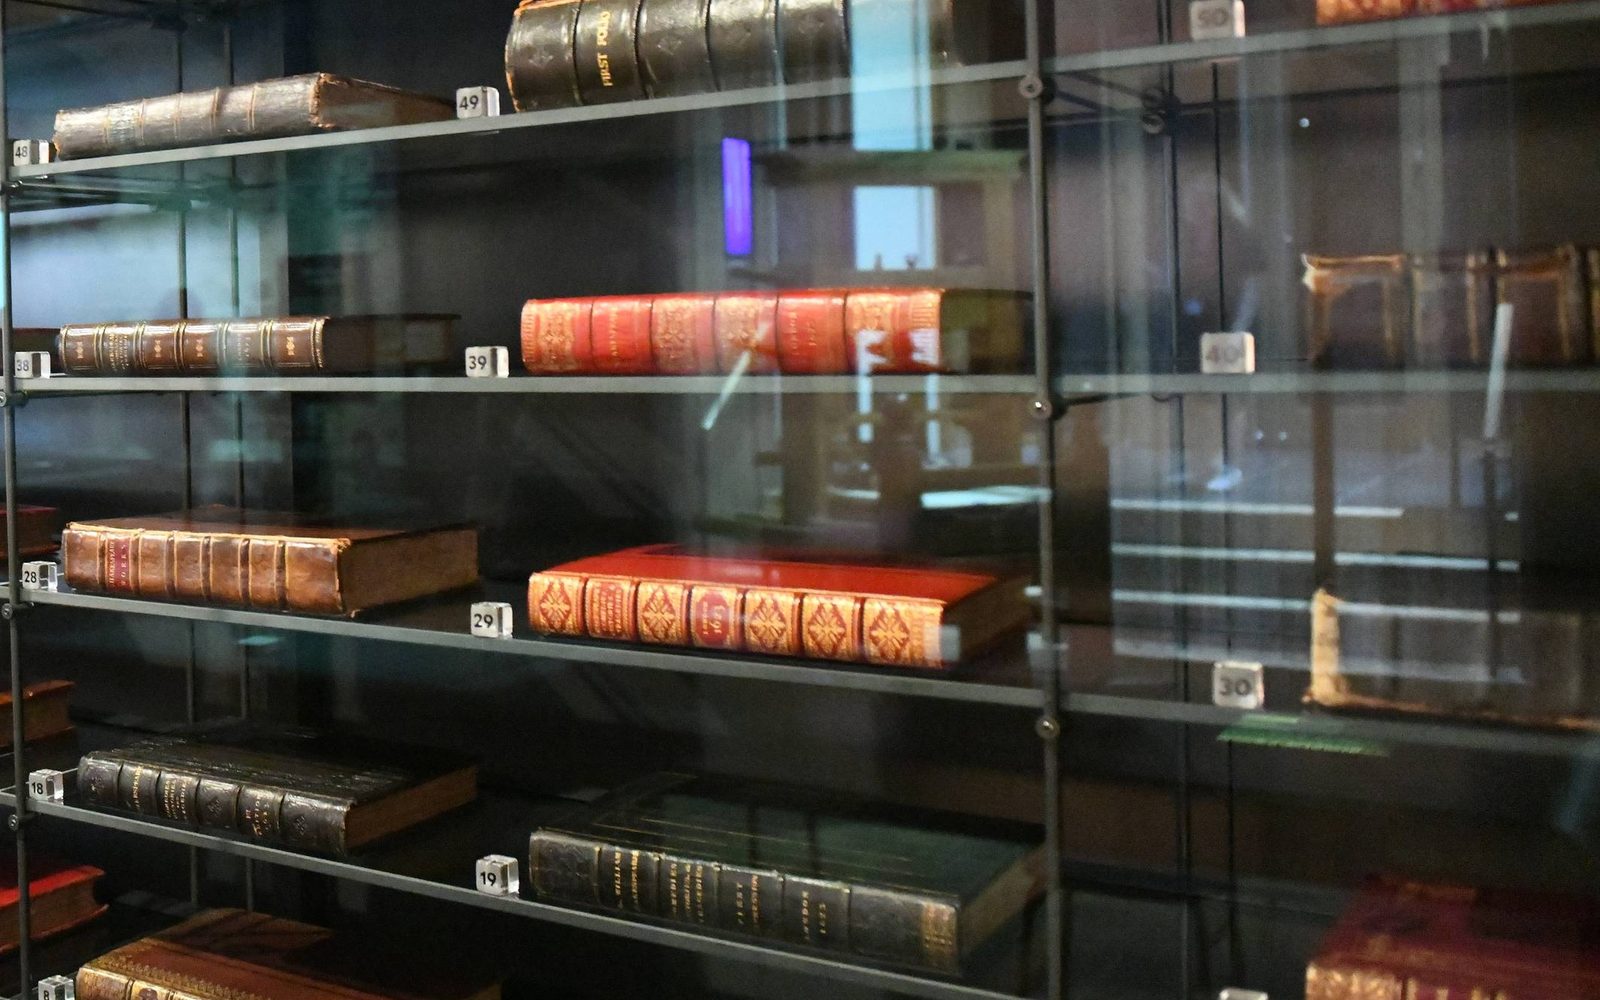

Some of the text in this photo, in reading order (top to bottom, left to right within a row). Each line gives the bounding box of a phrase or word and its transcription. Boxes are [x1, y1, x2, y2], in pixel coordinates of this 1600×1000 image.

[597, 11, 613, 87] FIRST FOLIO
[459, 94, 479, 110] 49
[15, 146, 28, 158] 48
[16, 359, 29, 371] 38
[469, 355, 487, 370] 39
[108, 540, 116, 585] HAKESPEARE
[24, 571, 37, 583] 28
[473, 613, 493, 628] 29
[1220, 678, 1252, 697] 30
[31, 782, 44, 795] 18
[480, 871, 497, 886] 19
